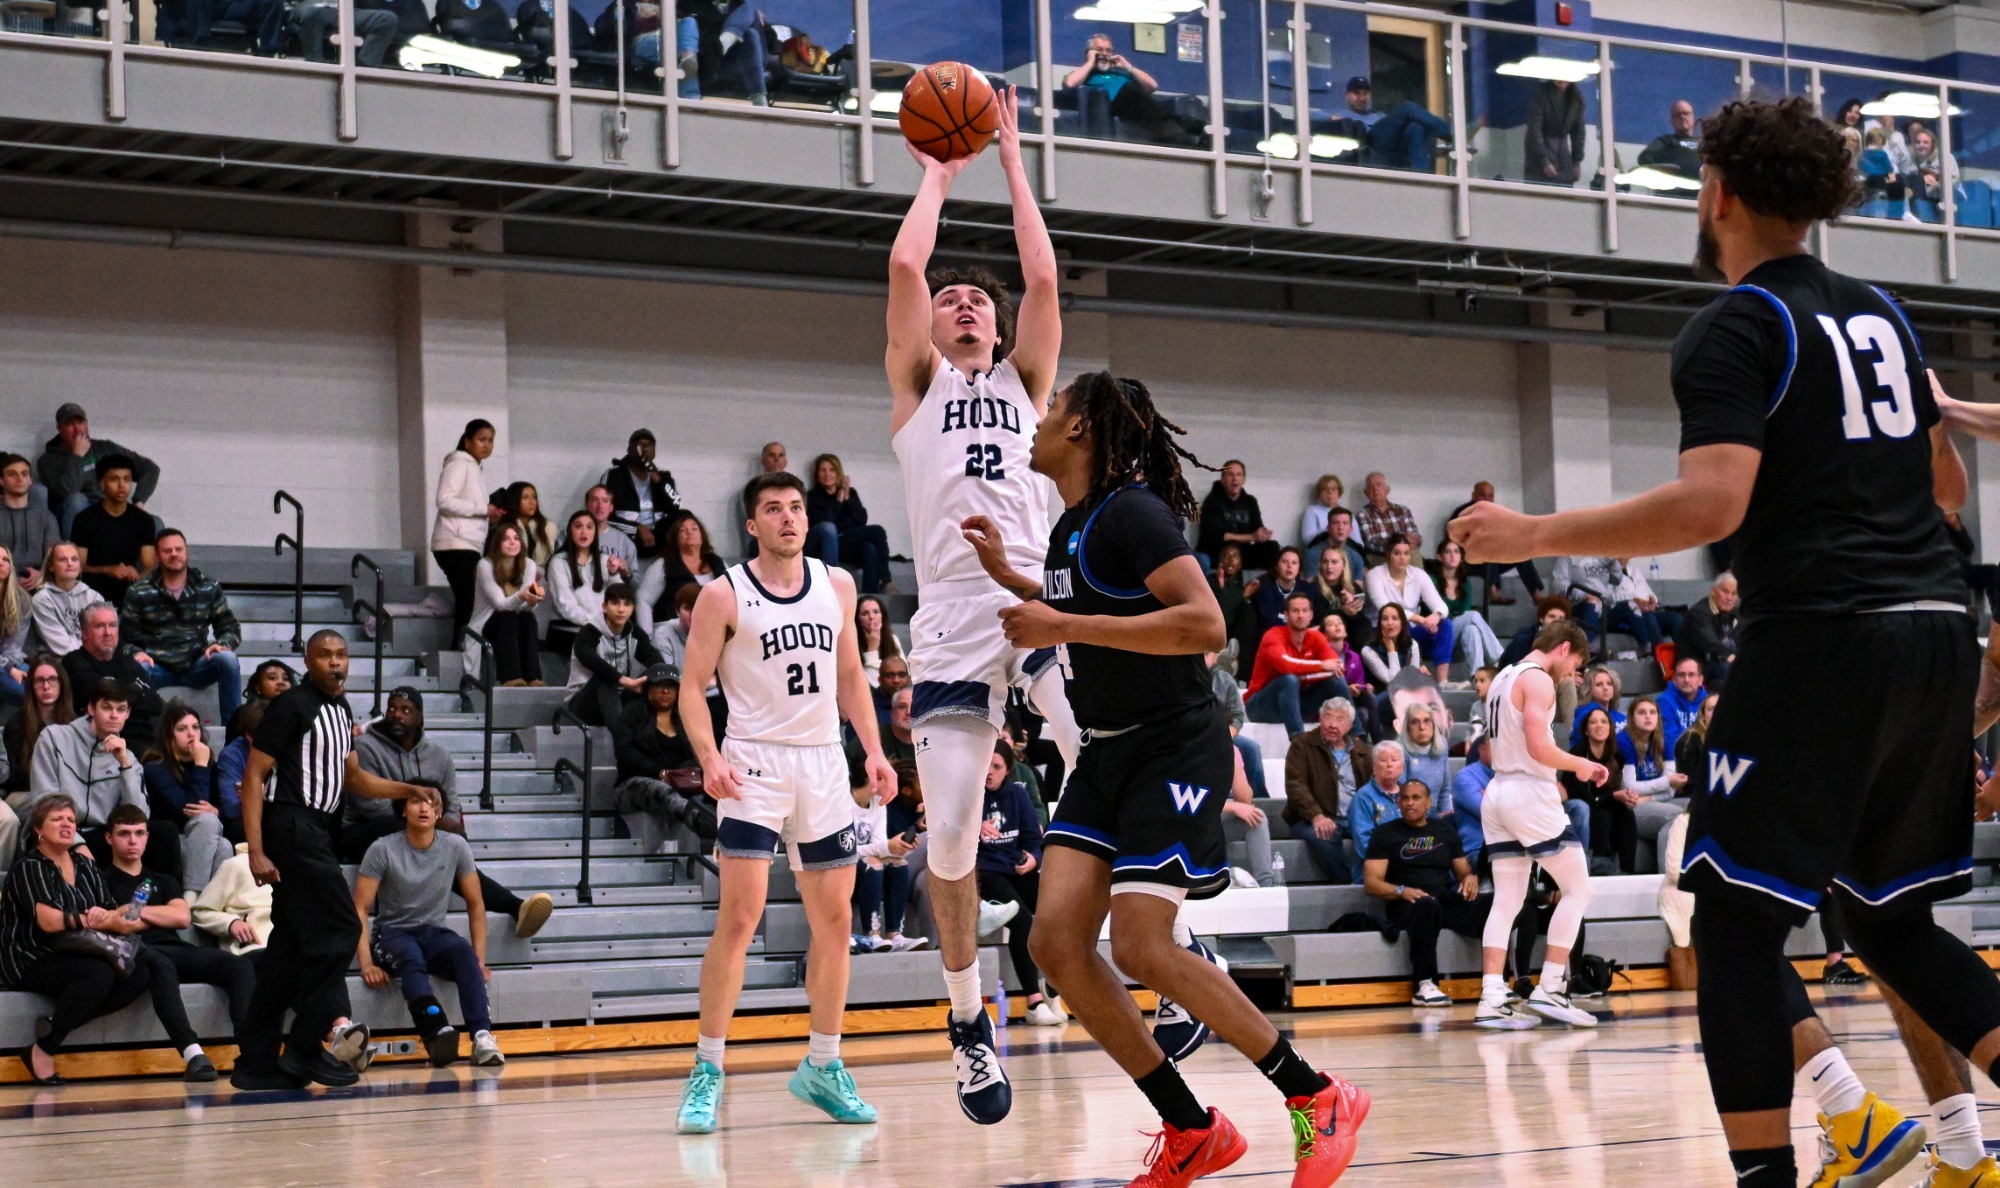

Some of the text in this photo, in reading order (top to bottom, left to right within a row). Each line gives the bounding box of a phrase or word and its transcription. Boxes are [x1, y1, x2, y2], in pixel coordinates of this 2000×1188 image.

[1815, 314, 1917, 439] 13
[942, 397, 1021, 434] HOOD
[965, 443, 1005, 480] 22
[760, 622, 833, 661] HOOD
[786, 661, 820, 696] 21
[1489, 694, 1501, 738] 11
[1709, 751, 1754, 795] W
[1168, 782, 1209, 814] W
